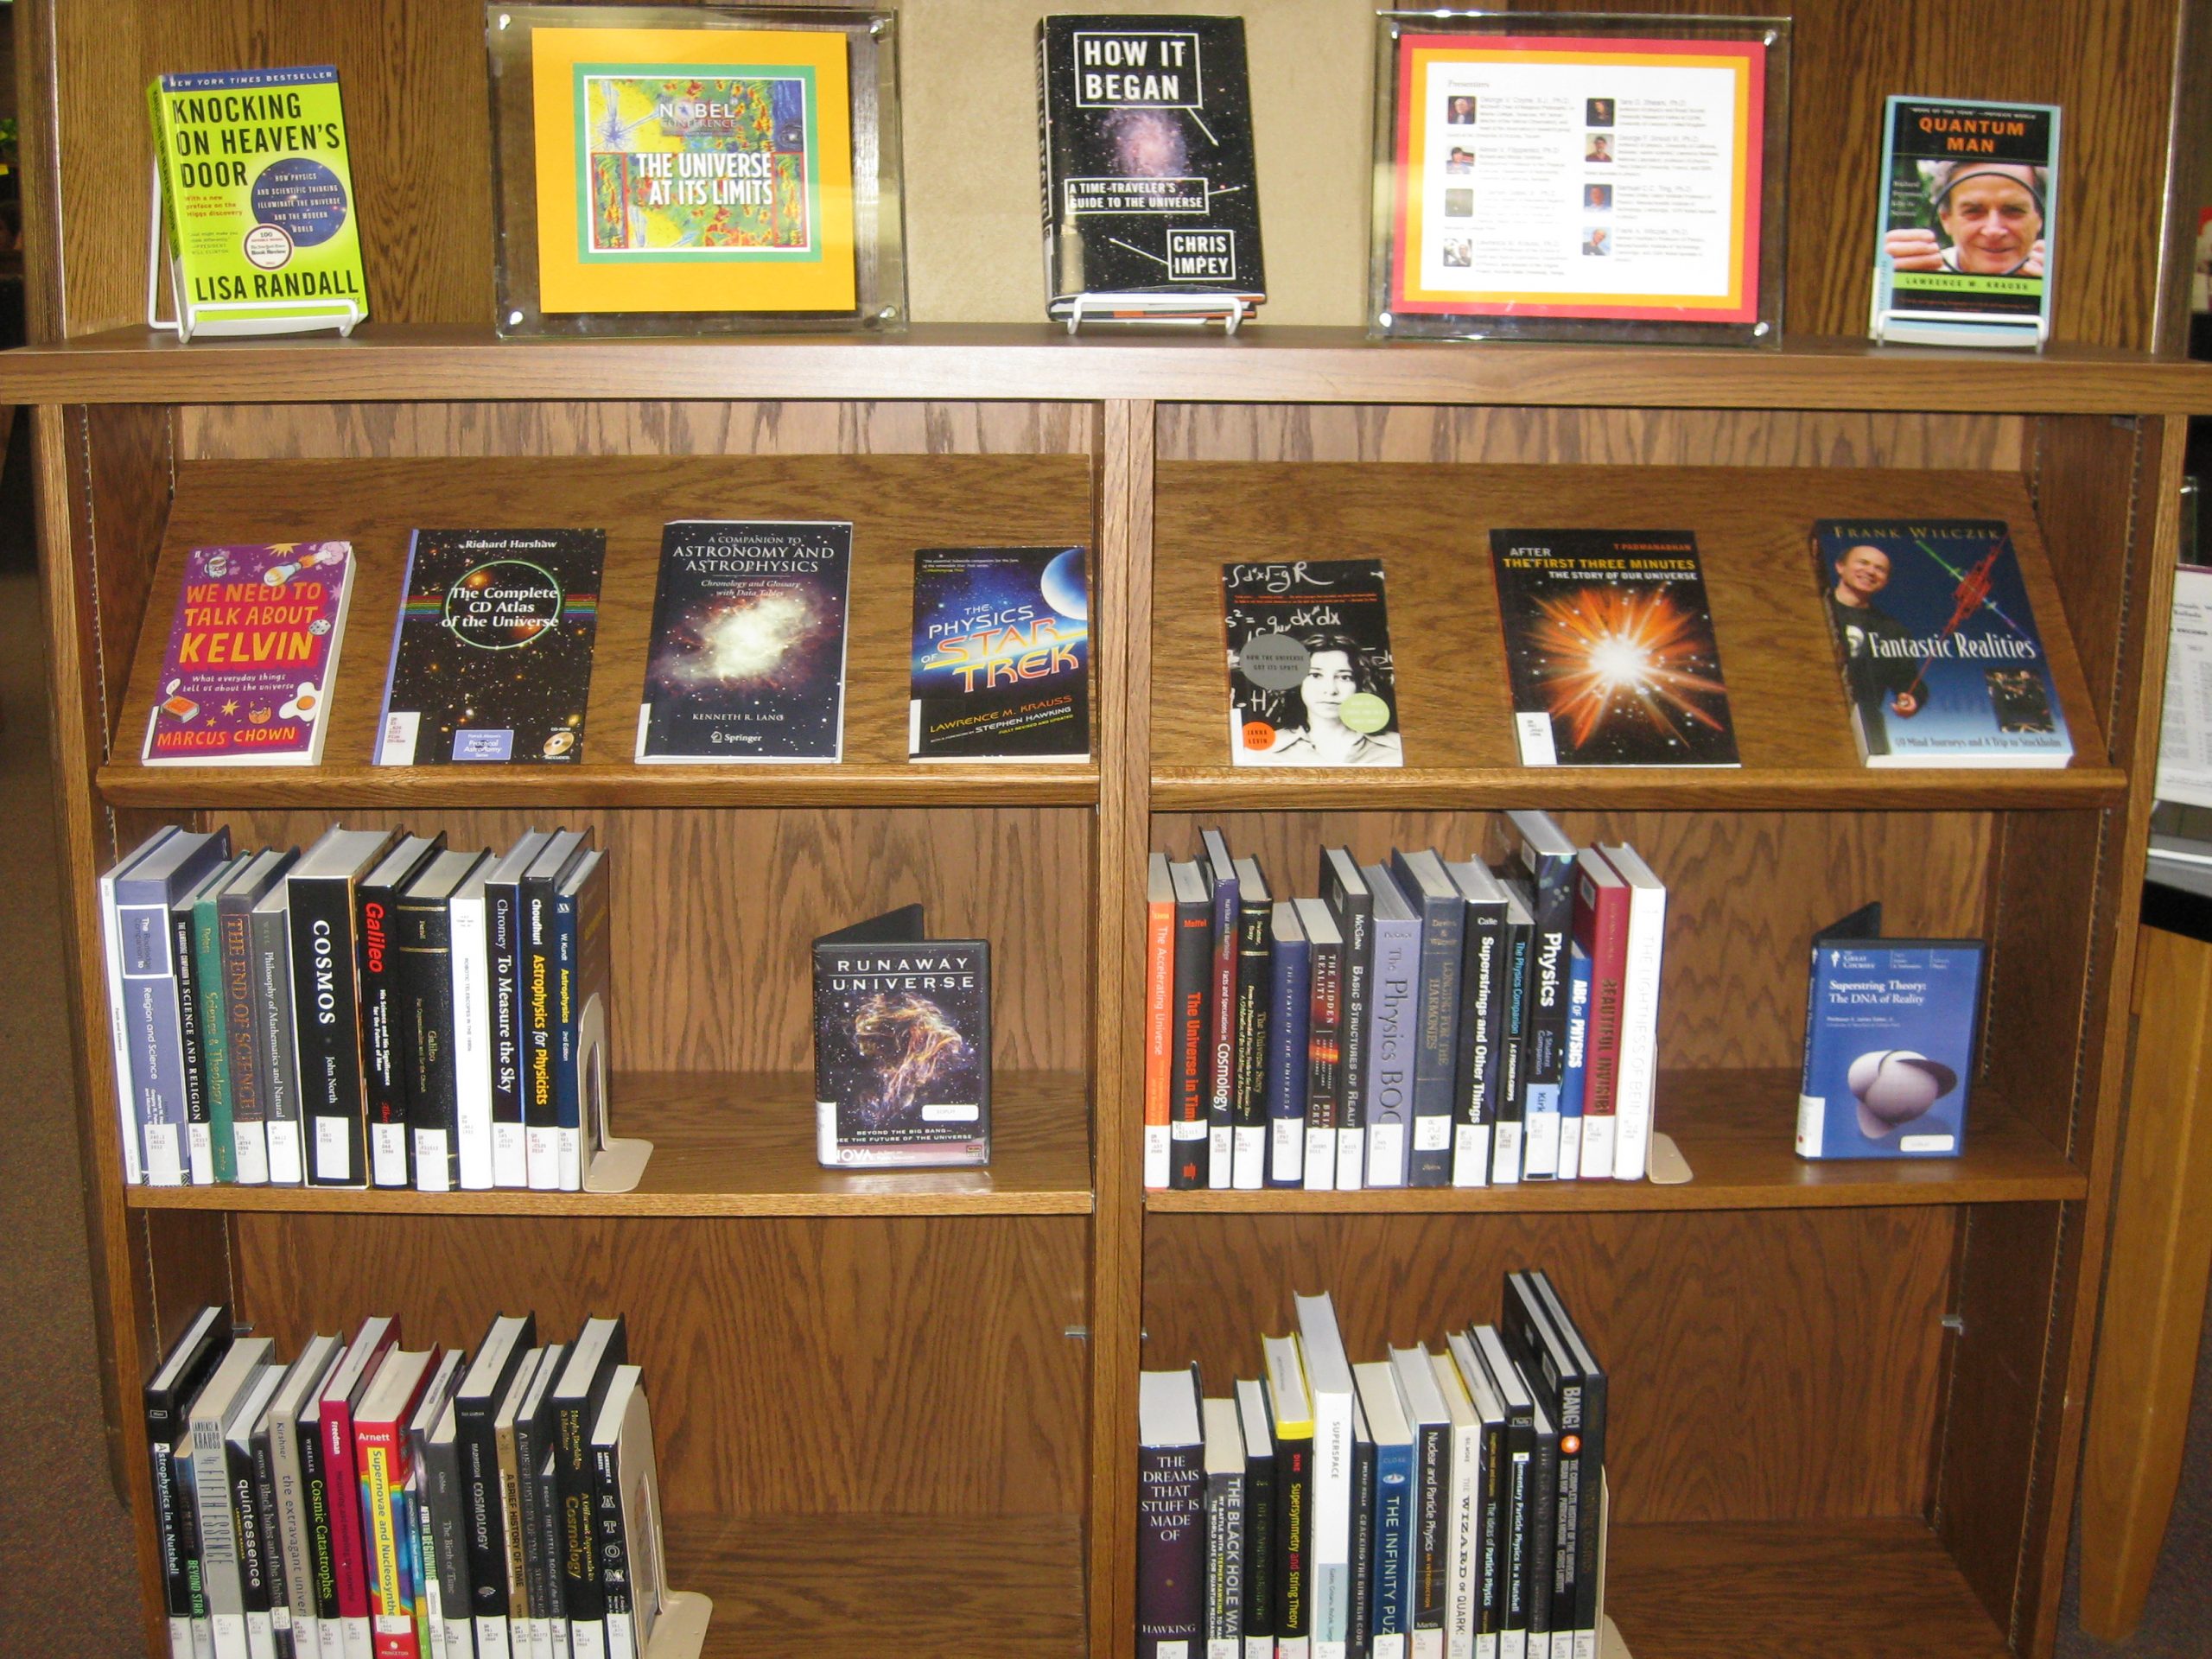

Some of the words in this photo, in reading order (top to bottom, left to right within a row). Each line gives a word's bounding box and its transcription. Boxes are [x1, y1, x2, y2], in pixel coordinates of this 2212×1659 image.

[1084, 41, 1147, 66] HOW
[1160, 41, 1185, 67] IT
[266, 72, 332, 82] BESTSELLER
[1086, 75, 1179, 99] BEGAN
[172, 93, 301, 124] KNOCKING
[1919, 118, 2024, 136] QUANTUM
[176, 130, 209, 156] ON
[223, 124, 340, 154] HEAVEN'S
[1948, 137, 1994, 152] MAN
[181, 162, 248, 188] DOOR
[637, 153, 672, 178] THE
[679, 153, 771, 178] UNIVERSE
[650, 180, 672, 205] AT
[679, 181, 706, 204] ITS
[713, 180, 772, 204] LIMITS
[1070, 183, 1077, 193] A
[1079, 183, 1176, 194] TIME-TRAVELER'S
[1070, 198, 1103, 207] GUIDE
[1108, 198, 1122, 207] TO
[1125, 198, 1145, 207] THE
[1150, 198, 1203, 207] UNIVERSE
[1173, 236, 1226, 252] CHRIS
[1175, 257, 1228, 274] IMPEY
[195, 276, 247, 301] LISA
[256, 270, 358, 298] RANDALL
[1834, 525, 1901, 538] FRANK
[1908, 527, 1999, 539] WILCZEK
[466, 540, 506, 549] Richard
[673, 546, 790, 558] ASTRONOMY
[794, 546, 834, 558] AND
[1510, 548, 1550, 557] AFTER
[685, 561, 818, 572] ASTROPHYSICS
[1503, 558, 1531, 569] THE
[1535, 559, 1574, 569] FIRST
[1580, 560, 1624, 569] THREE
[1630, 560, 1694, 569] MINUTES
[1645, 572, 1697, 581] UNIVERSE
[187, 584, 219, 603] WE
[226, 585, 286, 602] NEED
[293, 583, 321, 600] TO
[452, 588, 479, 599] The
[484, 588, 557, 601] Complete
[185, 607, 238, 626] TALK
[245, 607, 318, 626] ABOUT
[470, 602, 492, 613] CD
[496, 602, 535, 613] Atlas
[965, 604, 989, 614] THE
[442, 616, 458, 628] of
[462, 616, 486, 627] the
[493, 616, 559, 627] Universe
[929, 606, 1033, 639] PHYSICS
[180, 632, 313, 663] KELVIN
[924, 618, 1087, 671] STAR
[1868, 632, 1951, 658] Fantastic
[1954, 632, 2036, 658] Realities
[921, 654, 938, 663] OF
[953, 643, 1078, 693] TREK
[218, 674, 256, 683] everyday
[259, 673, 285, 682] things
[930, 712, 999, 733] LAWRENCE
[1021, 696, 1071, 712] KRAUSS
[976, 717, 1022, 733] STEPHEN
[1026, 707, 1071, 721] HAWKING
[158, 732, 226, 746] MARCUS
[234, 727, 296, 741] CHOWN
[725, 734, 761, 742] Springer
[497, 899, 507, 950] Chromey
[531, 899, 543, 945] Choudhuri
[365, 902, 385, 973] Galileo
[1158, 927, 1167, 944] The
[313, 920, 335, 1024] COSMOS
[498, 955, 512, 973] To
[838, 958, 967, 971] RUNAWAY
[1540, 932, 1562, 1007] Physics
[833, 976, 974, 990] UNIVERSE
[1154, 948, 1166, 1010] Accelerating
[1476, 937, 1494, 1016] Superstrings
[1829, 981, 1885, 991] Superstring
[1889, 981, 1926, 992] Theory:
[532, 955, 546, 1029] Astrophysics
[1573, 980, 1587, 1004] ABC
[1829, 995, 1847, 1003] The
[1851, 995, 1878, 1003] DNA
[1880, 995, 1890, 1003] of
[1892, 995, 1924, 1005] Reality
[143, 987, 154, 1021] Religion
[499, 977, 513, 1037] Measure
[1573, 1005, 1582, 1016] OF
[146, 1024, 155, 1042] and
[532, 1031, 548, 1046] for
[1155, 1014, 1165, 1055] Universe
[1477, 1020, 1487, 1043] and
[500, 1039, 514, 1062] the
[1568, 1019, 1585, 1068] PHYSICS
[147, 1043, 158, 1079] Science
[326, 1056, 335, 1076] John
[1474, 1046, 1487, 1080] Other
[499, 1067, 514, 1093] Sky
[534, 1049, 548, 1104] Physicists
[1213, 1044, 1230, 1111] Cosmology
[328, 1078, 337, 1103] North
[1469, 1083, 1484, 1123] Things
[1562, 1386, 1581, 1430] BANG!
[359, 1433, 390, 1442] Arnett
[1157, 1456, 1185, 1468] THE
[1143, 1470, 1199, 1482] DREAMS
[311, 1480, 326, 1522] Cosmic
[1151, 1485, 1190, 1497] THAT
[1141, 1501, 1184, 1511] STUFF
[1188, 1500, 1198, 1510] IS
[1386, 1495, 1400, 1527] THE
[1150, 1515, 1191, 1526] MADE
[1287, 1484, 1301, 1553] Supersymmetry
[238, 1479, 260, 1586] quintessence
[1160, 1529, 1180, 1541] OF
[315, 1525, 332, 1599] Catastrophes
[1289, 1554, 1300, 1570] and
[1383, 1533, 1398, 1601] INFINITY
[1288, 1572, 1299, 1598] String
[1287, 1600, 1297, 1629] Theory
[1142, 1624, 1195, 1633] HAWKING
